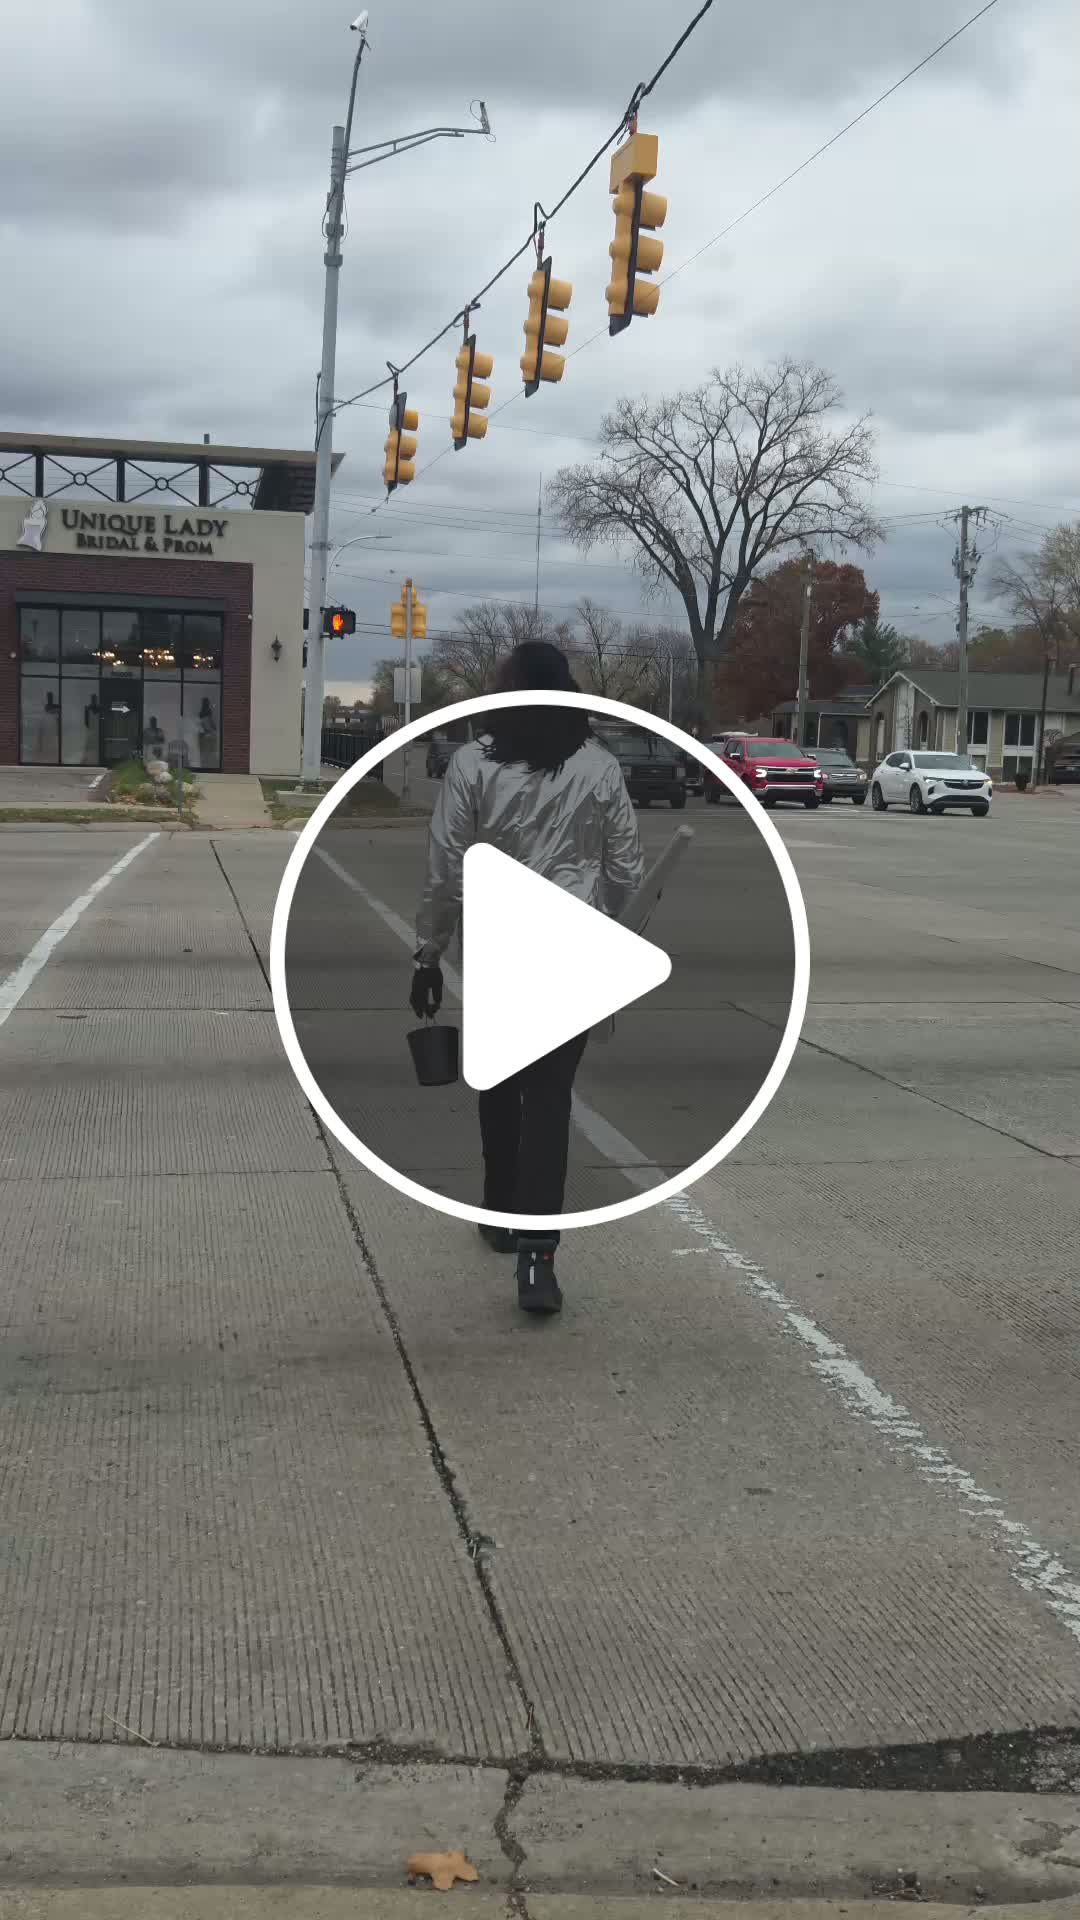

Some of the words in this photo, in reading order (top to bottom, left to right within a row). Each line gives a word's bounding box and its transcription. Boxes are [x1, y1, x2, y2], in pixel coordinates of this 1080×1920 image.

[61, 509, 155, 534] UNIQUE
[164, 515, 228, 537] LADY
[76, 533, 140, 551] BRIDAL
[144, 536, 159, 552] &
[163, 537, 213, 554] PROM
